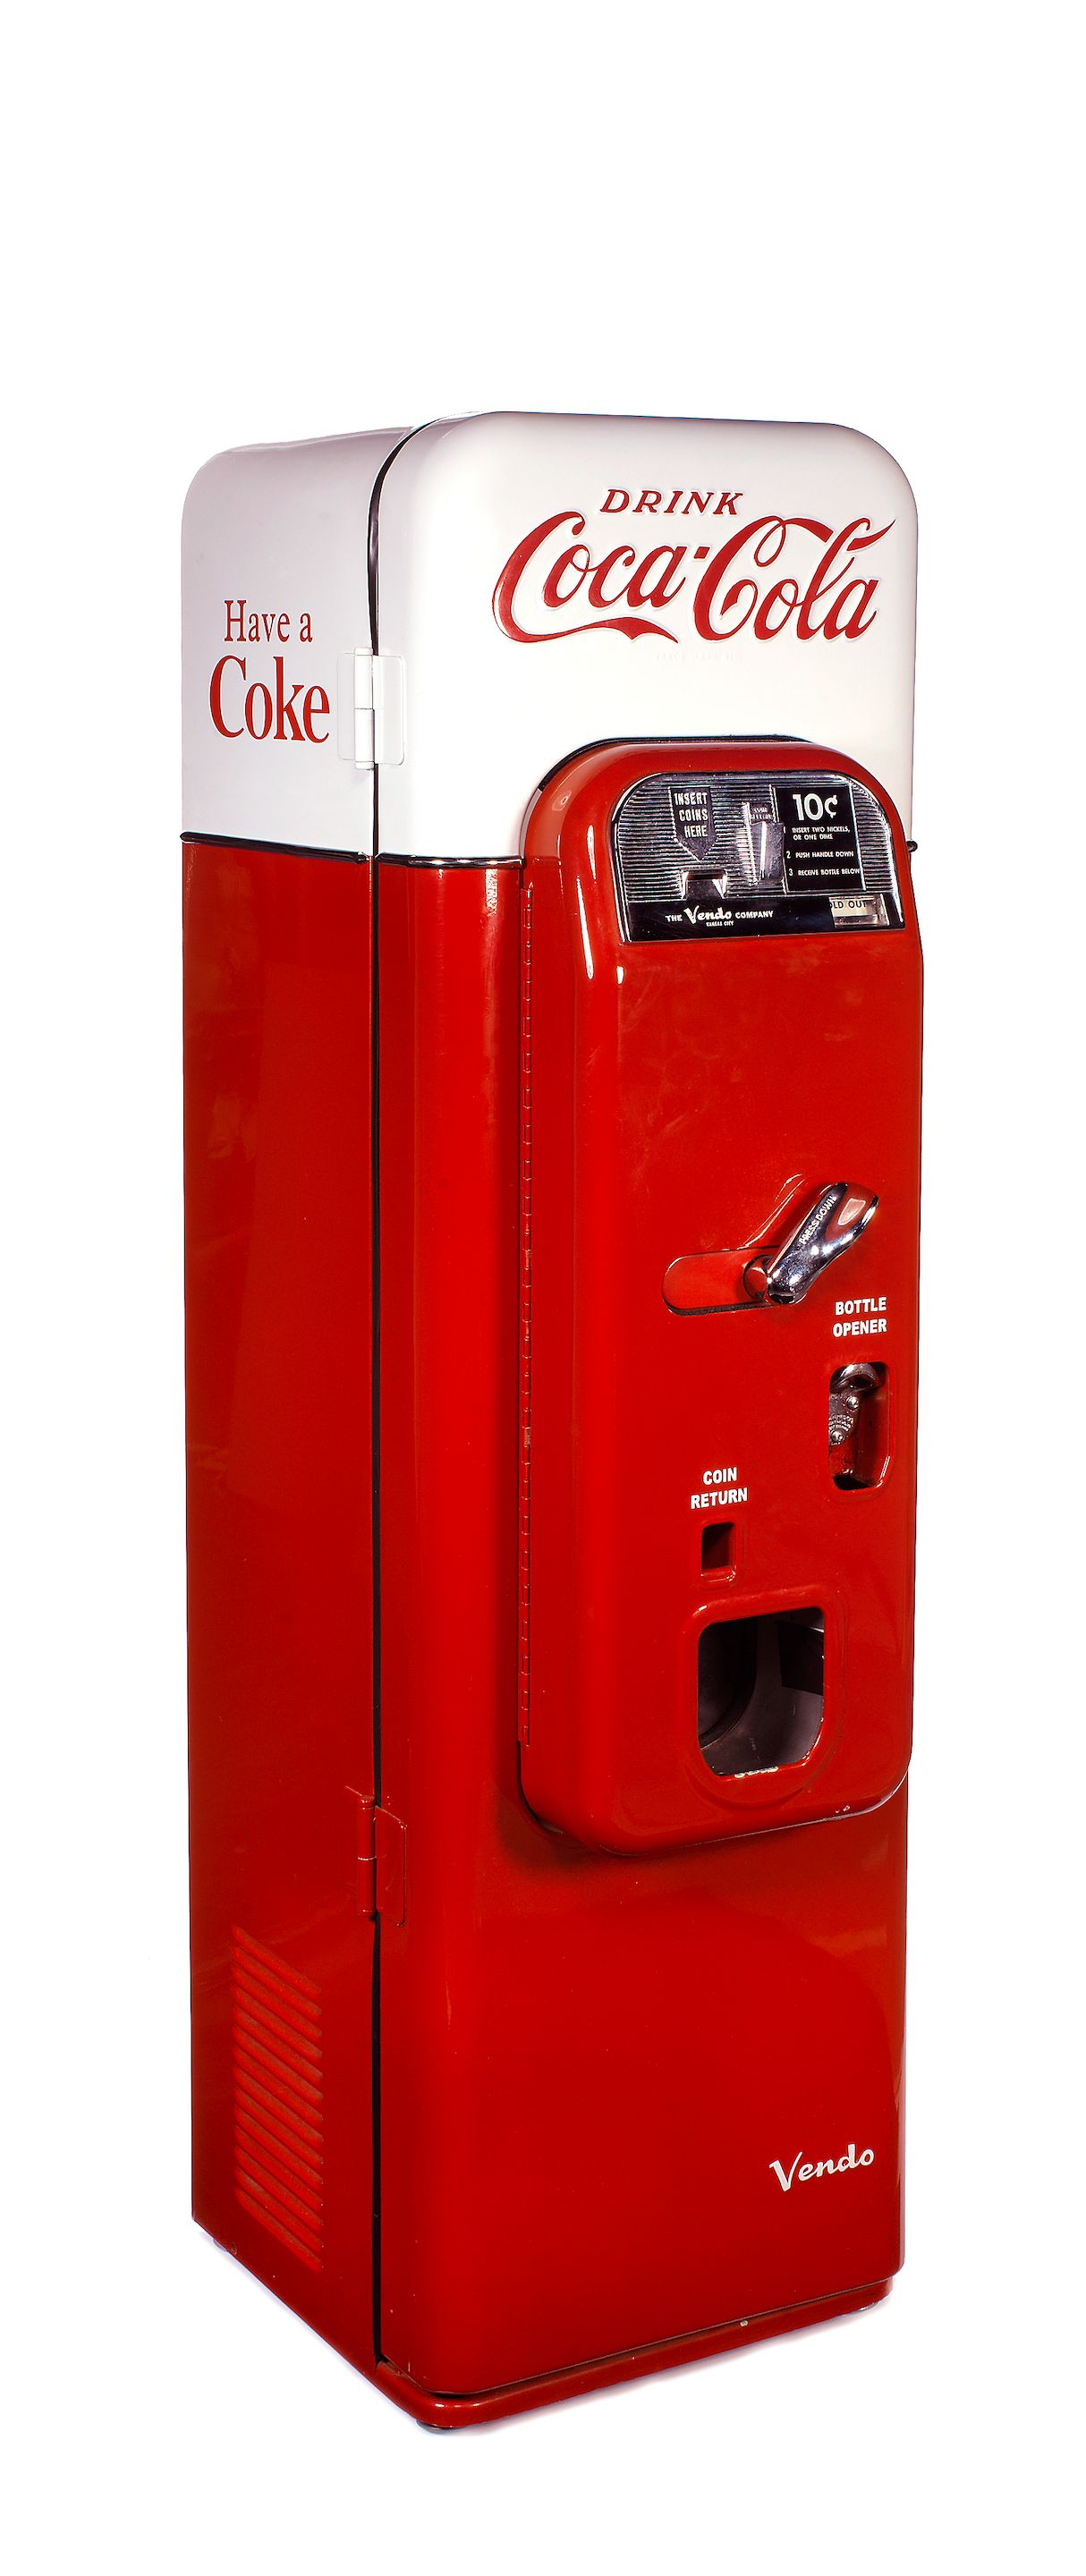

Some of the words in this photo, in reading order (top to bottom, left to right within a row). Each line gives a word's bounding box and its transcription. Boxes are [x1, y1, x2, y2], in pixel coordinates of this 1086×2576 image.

[599, 488, 744, 516] DRINK
[491, 511, 896, 644] Coca-Cola
[224, 599, 291, 642] Have
[300, 613, 313, 643] a
[209, 655, 330, 743] Coke
[674, 792, 708, 806] INSERT
[792, 793, 838, 821] 10¢
[679, 809, 708, 822] COINS
[684, 825, 708, 839] HERE
[786, 851, 791, 859] 2
[788, 869, 793, 877] 3
[665, 914, 683, 923] THE
[683, 904, 733, 925] Vendo
[734, 911, 774, 919] COMPANY
[817, 1195, 837, 1222] DOWN
[835, 1296, 887, 1316] BOTTLE
[833, 1318, 887, 1338] OPENER
[702, 1466, 738, 1486] COIN
[691, 1487, 748, 1510] RETURN
[768, 2143, 875, 2192] Vendo
